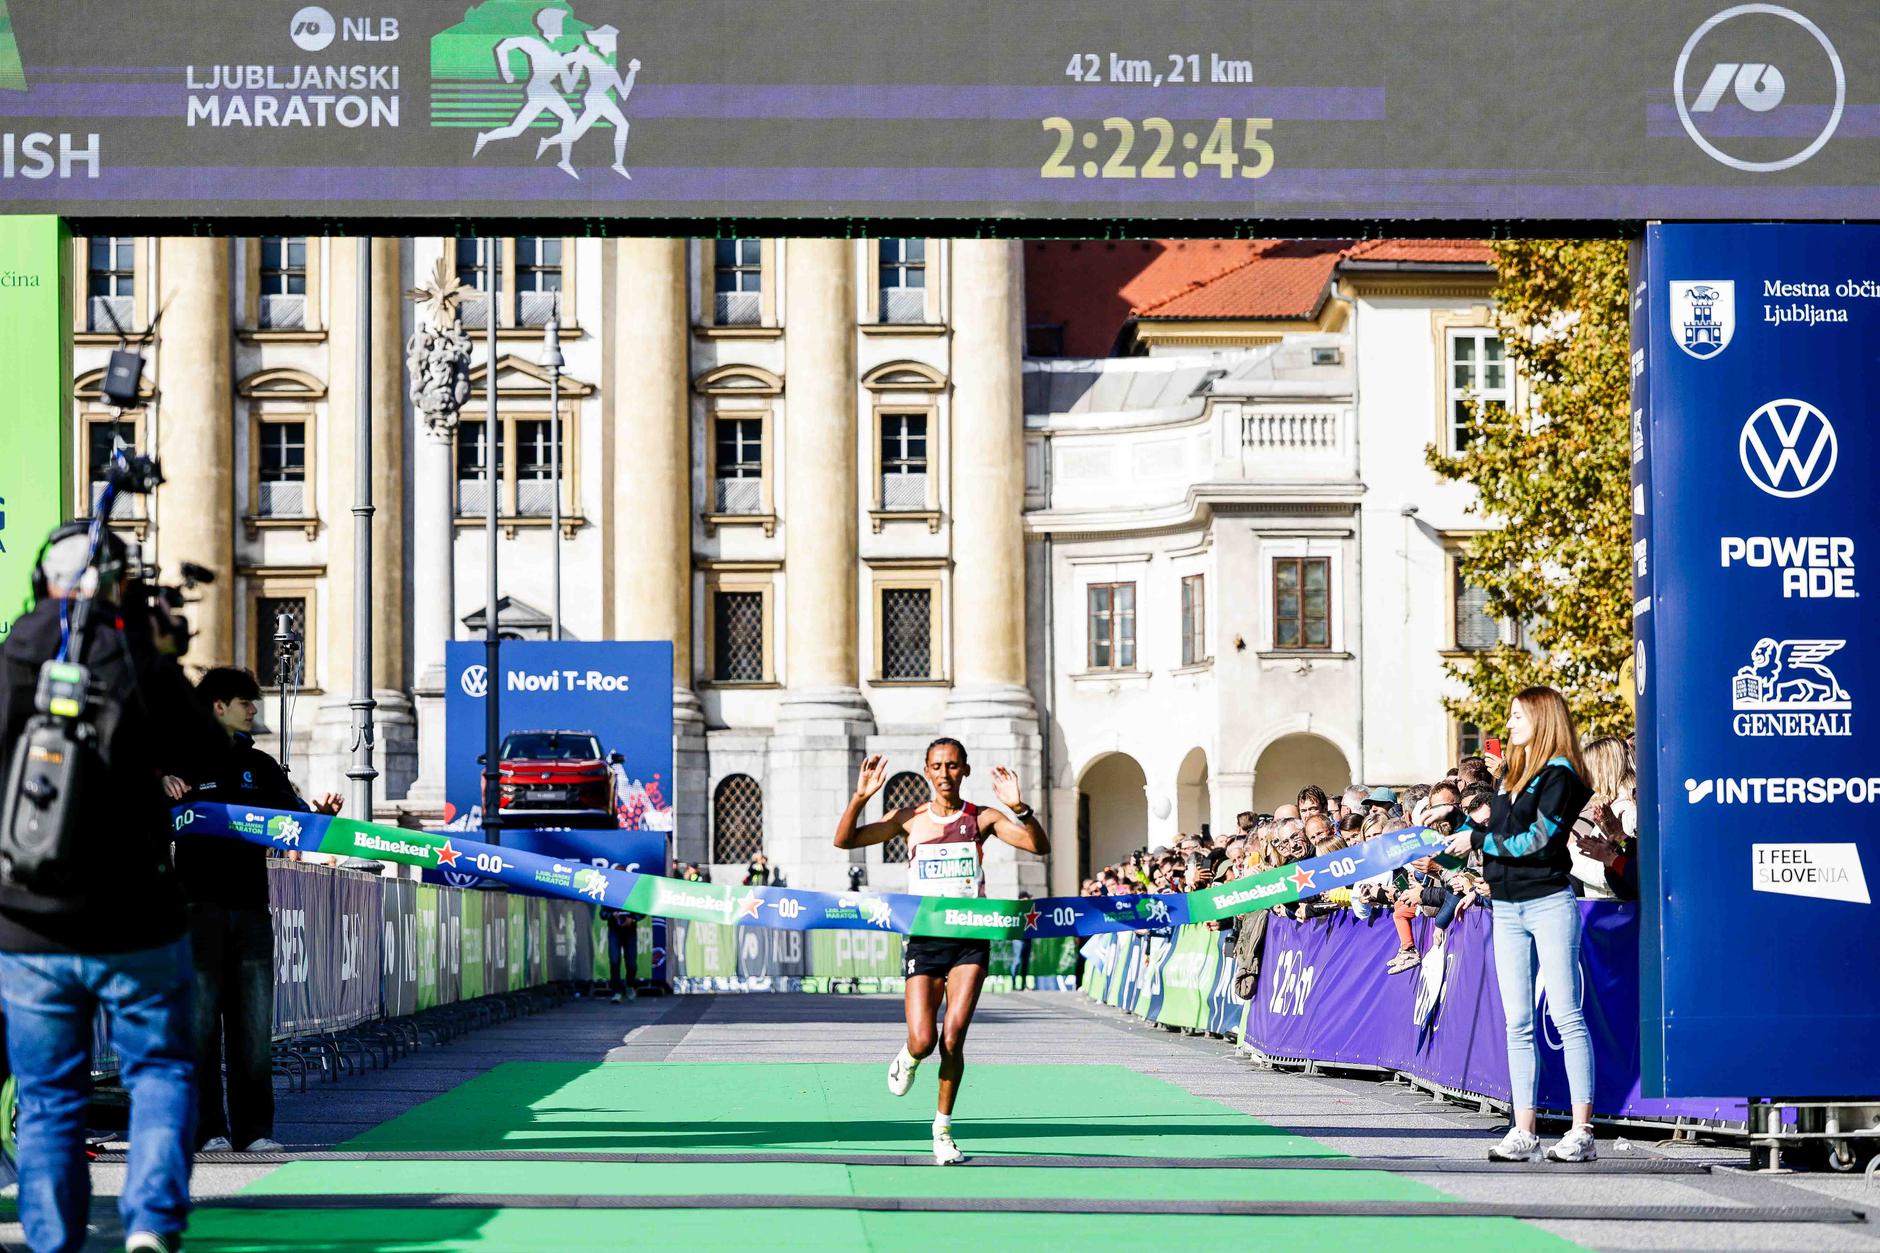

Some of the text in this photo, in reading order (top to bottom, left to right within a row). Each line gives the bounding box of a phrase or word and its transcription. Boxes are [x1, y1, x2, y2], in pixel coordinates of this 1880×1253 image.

[342, 16, 400, 42] NLB
[186, 65, 400, 91] LJUBLJANSKI
[1065, 54, 1101, 82] 42
[1210, 53, 1254, 82] km
[186, 96, 400, 128] MARATON
[2, 133, 100, 180] ISH
[1040, 116, 1275, 180] 2:22:45
[1763, 279, 1829, 297] Mestna
[1763, 304, 1848, 326] Ljubljana
[1720, 536, 1855, 568] POWER
[1783, 567, 1856, 598] ADE
[507, 670, 630, 692] Novi T-Roc
[1733, 712, 1853, 737] GENERALI
[354, 832, 431, 858] Heineken
[1758, 850, 1813, 864] I FEEL
[1758, 867, 1849, 883] SLOVENIA
[1212, 880, 1288, 909] Heineken
[944, 909, 1021, 928] Heineken
